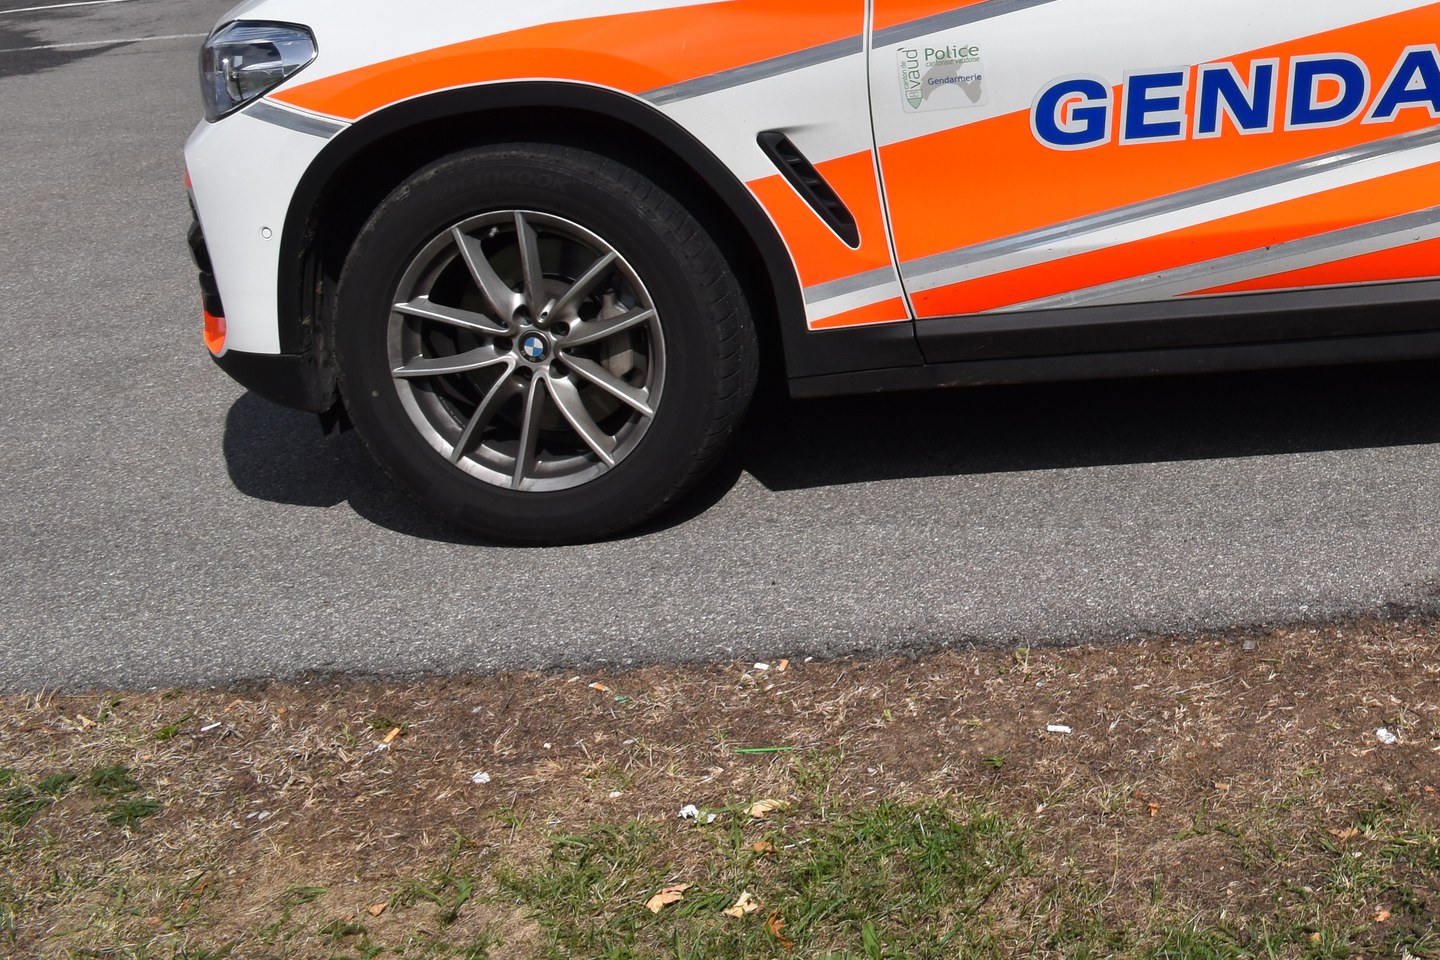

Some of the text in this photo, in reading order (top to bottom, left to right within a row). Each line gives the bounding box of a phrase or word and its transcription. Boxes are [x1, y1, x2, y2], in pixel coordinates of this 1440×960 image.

[924, 45, 979, 61] Police
[902, 49, 921, 90] vaud
[925, 57, 980, 67] cantonale vaudoise
[900, 61, 909, 90] canton de
[927, 73, 982, 86] Gendarmerie
